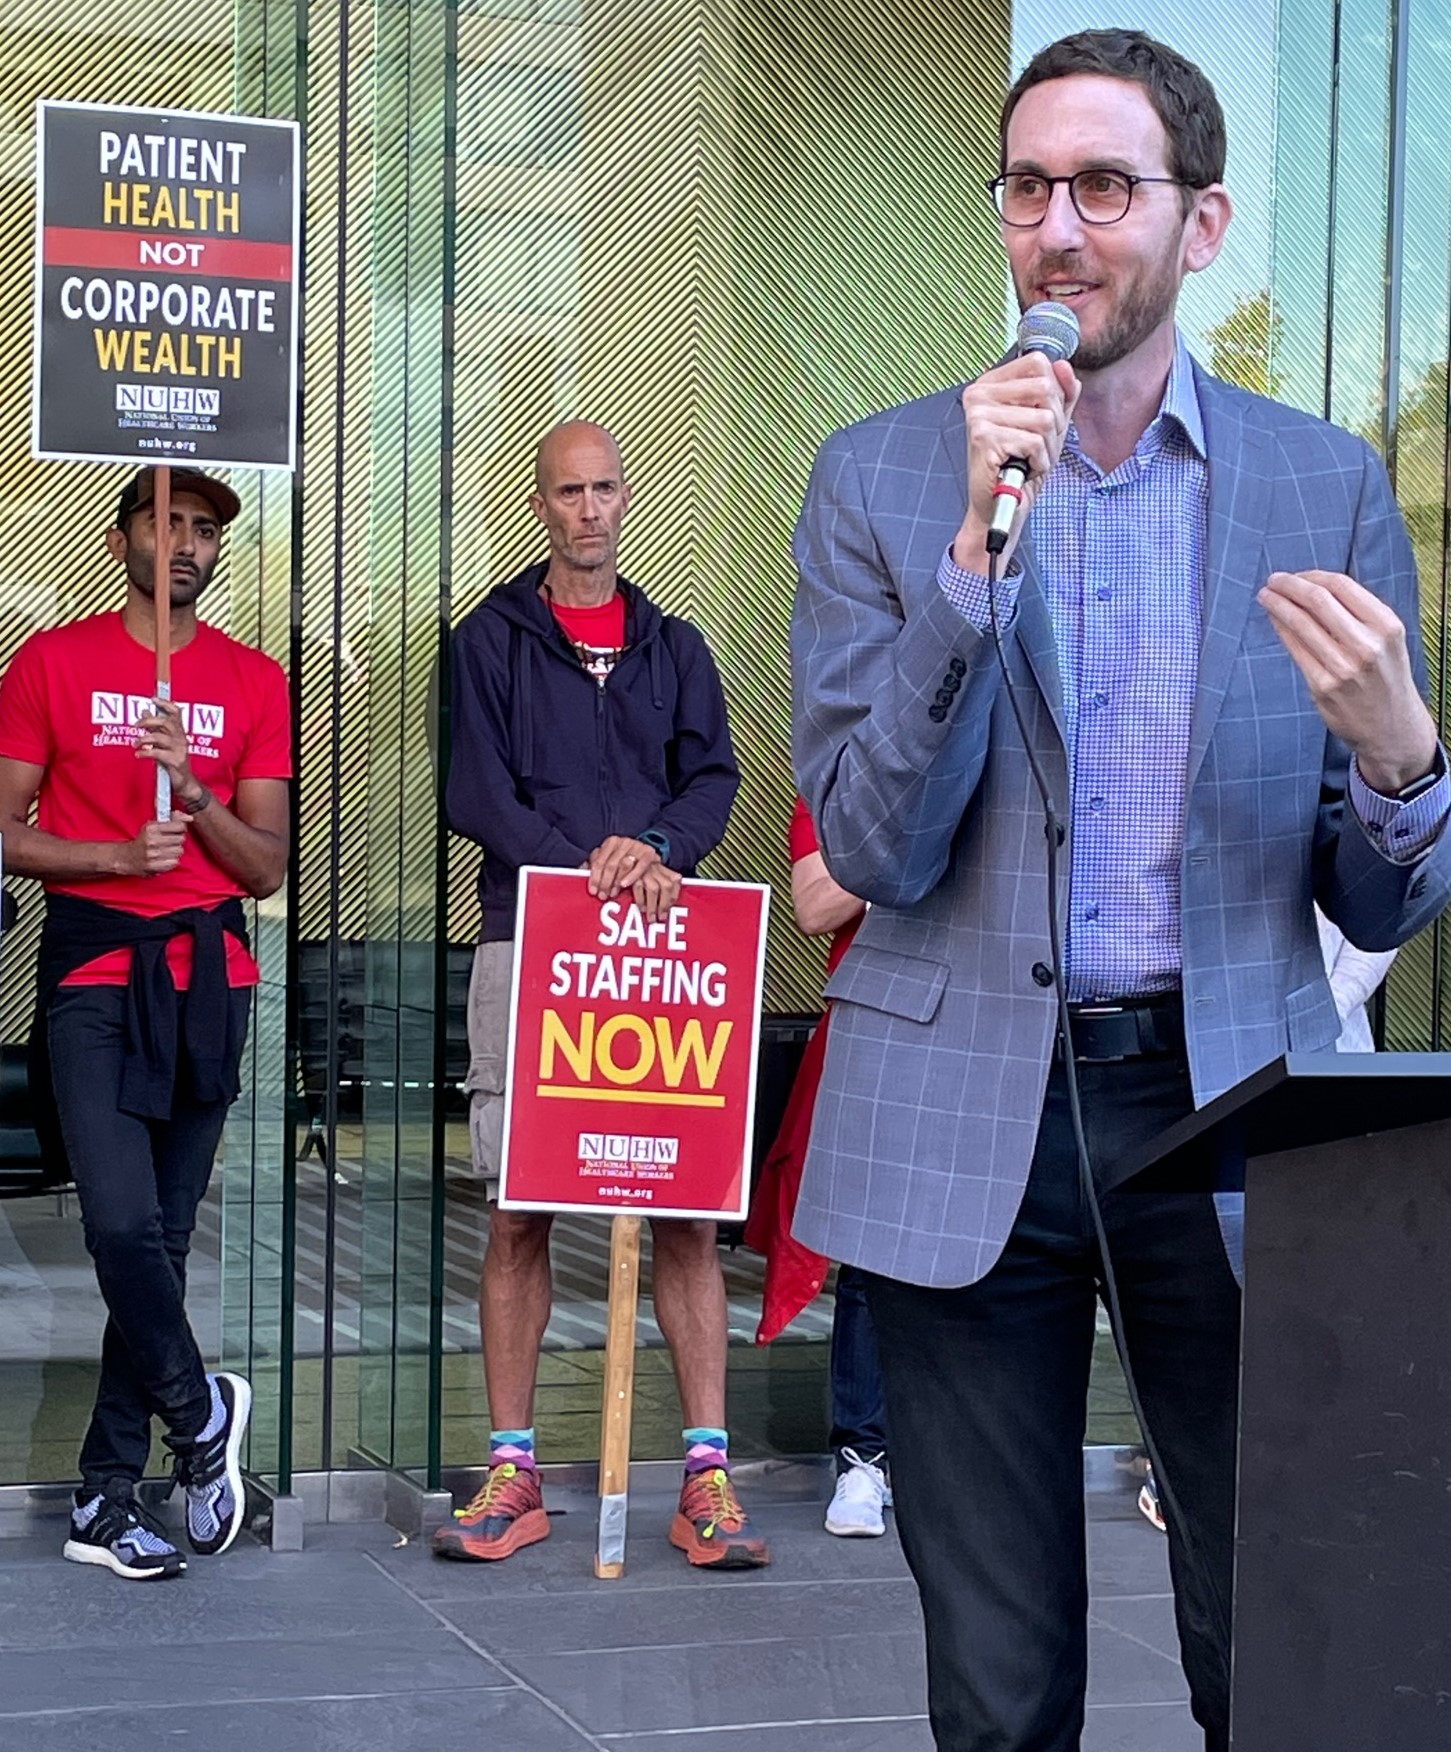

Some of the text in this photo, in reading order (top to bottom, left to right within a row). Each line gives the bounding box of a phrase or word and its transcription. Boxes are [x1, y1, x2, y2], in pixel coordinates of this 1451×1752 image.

[100, 130, 247, 185] PATIENT
[102, 181, 240, 233] HEALTH
[139, 240, 205, 268] NOT
[60, 276, 276, 333] CORPORATE
[94, 328, 242, 379] WEALTH
[118, 386, 219, 413] NUHW
[138, 437, 197, 452] nuhw.org
[94, 694, 222, 734] NUW
[102, 724, 147, 737] NATION
[549, 951, 727, 1008] STAFFING
[538, 1008, 734, 1090] NOW
[580, 1135, 677, 1160] NUHW
[598, 1185, 653, 1200] nuhw.org
